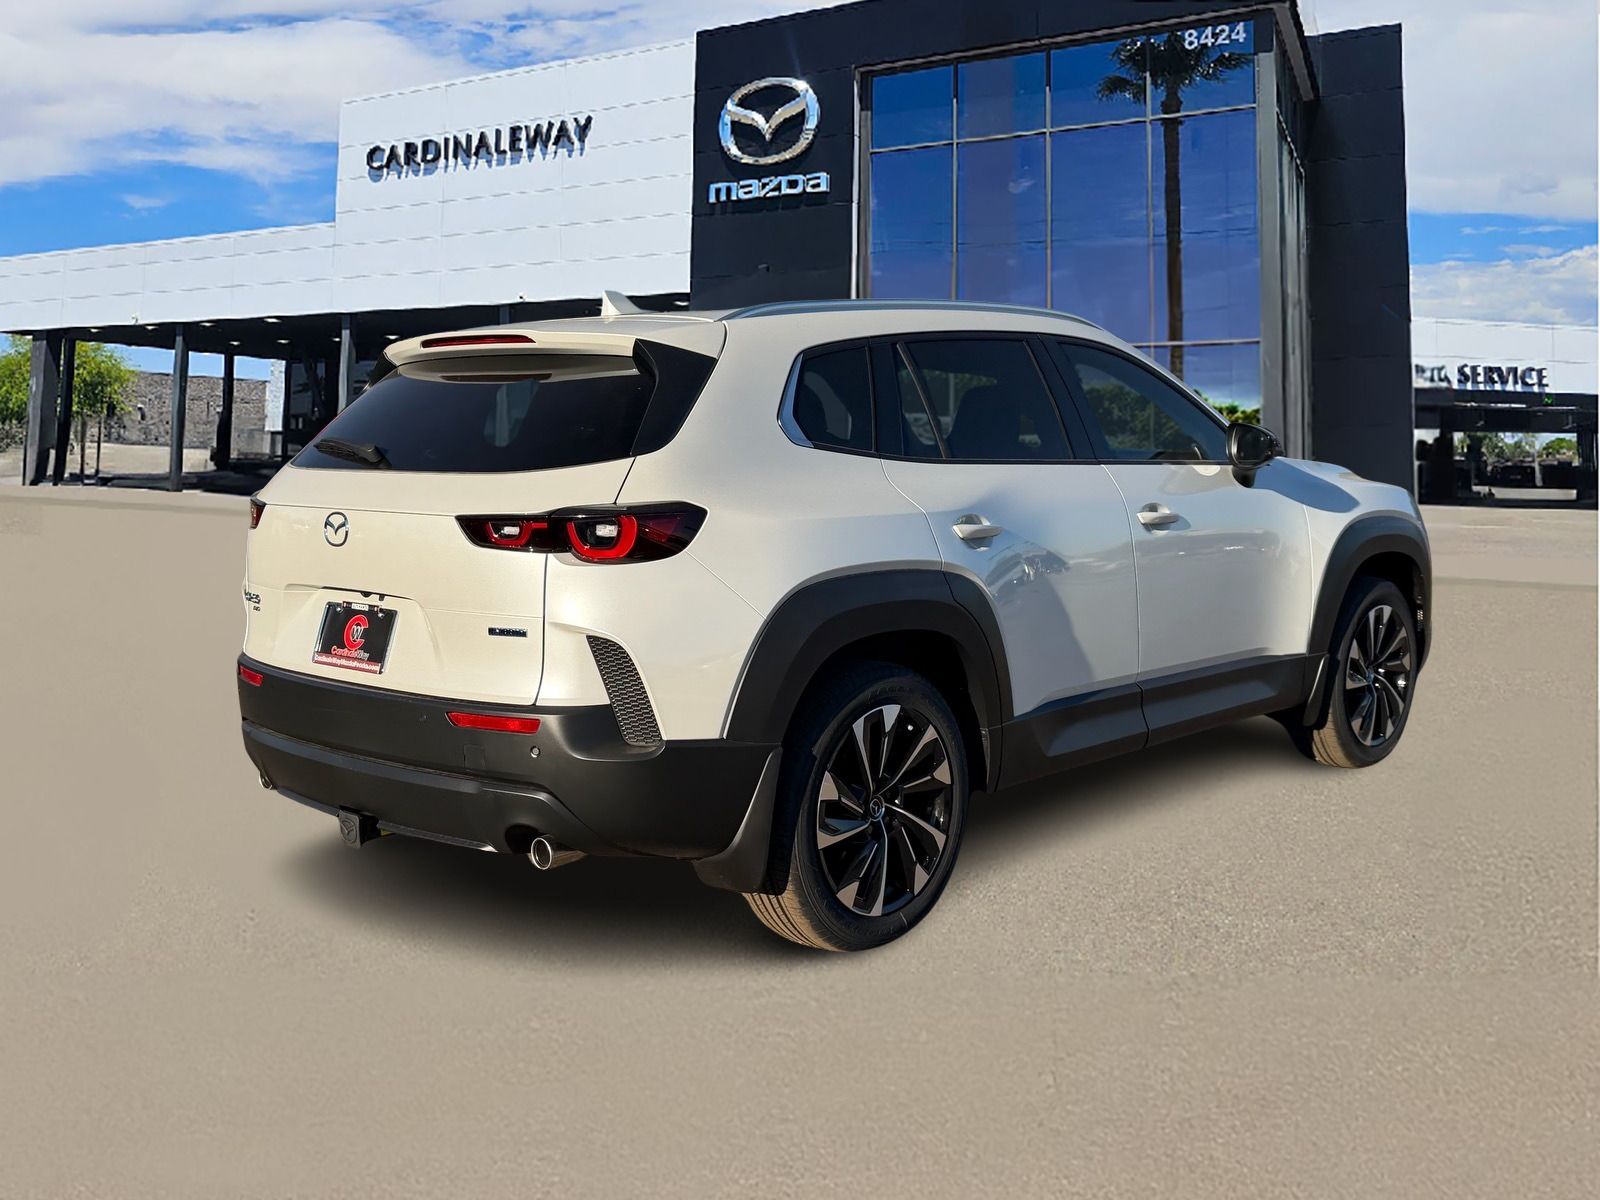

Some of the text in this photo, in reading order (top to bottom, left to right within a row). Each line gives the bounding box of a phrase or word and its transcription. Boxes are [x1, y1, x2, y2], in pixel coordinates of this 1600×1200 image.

[1184, 22, 1247, 50] 8424
[366, 115, 593, 170] CARDINALEWAY
[1457, 363, 1549, 387] SERVICE
